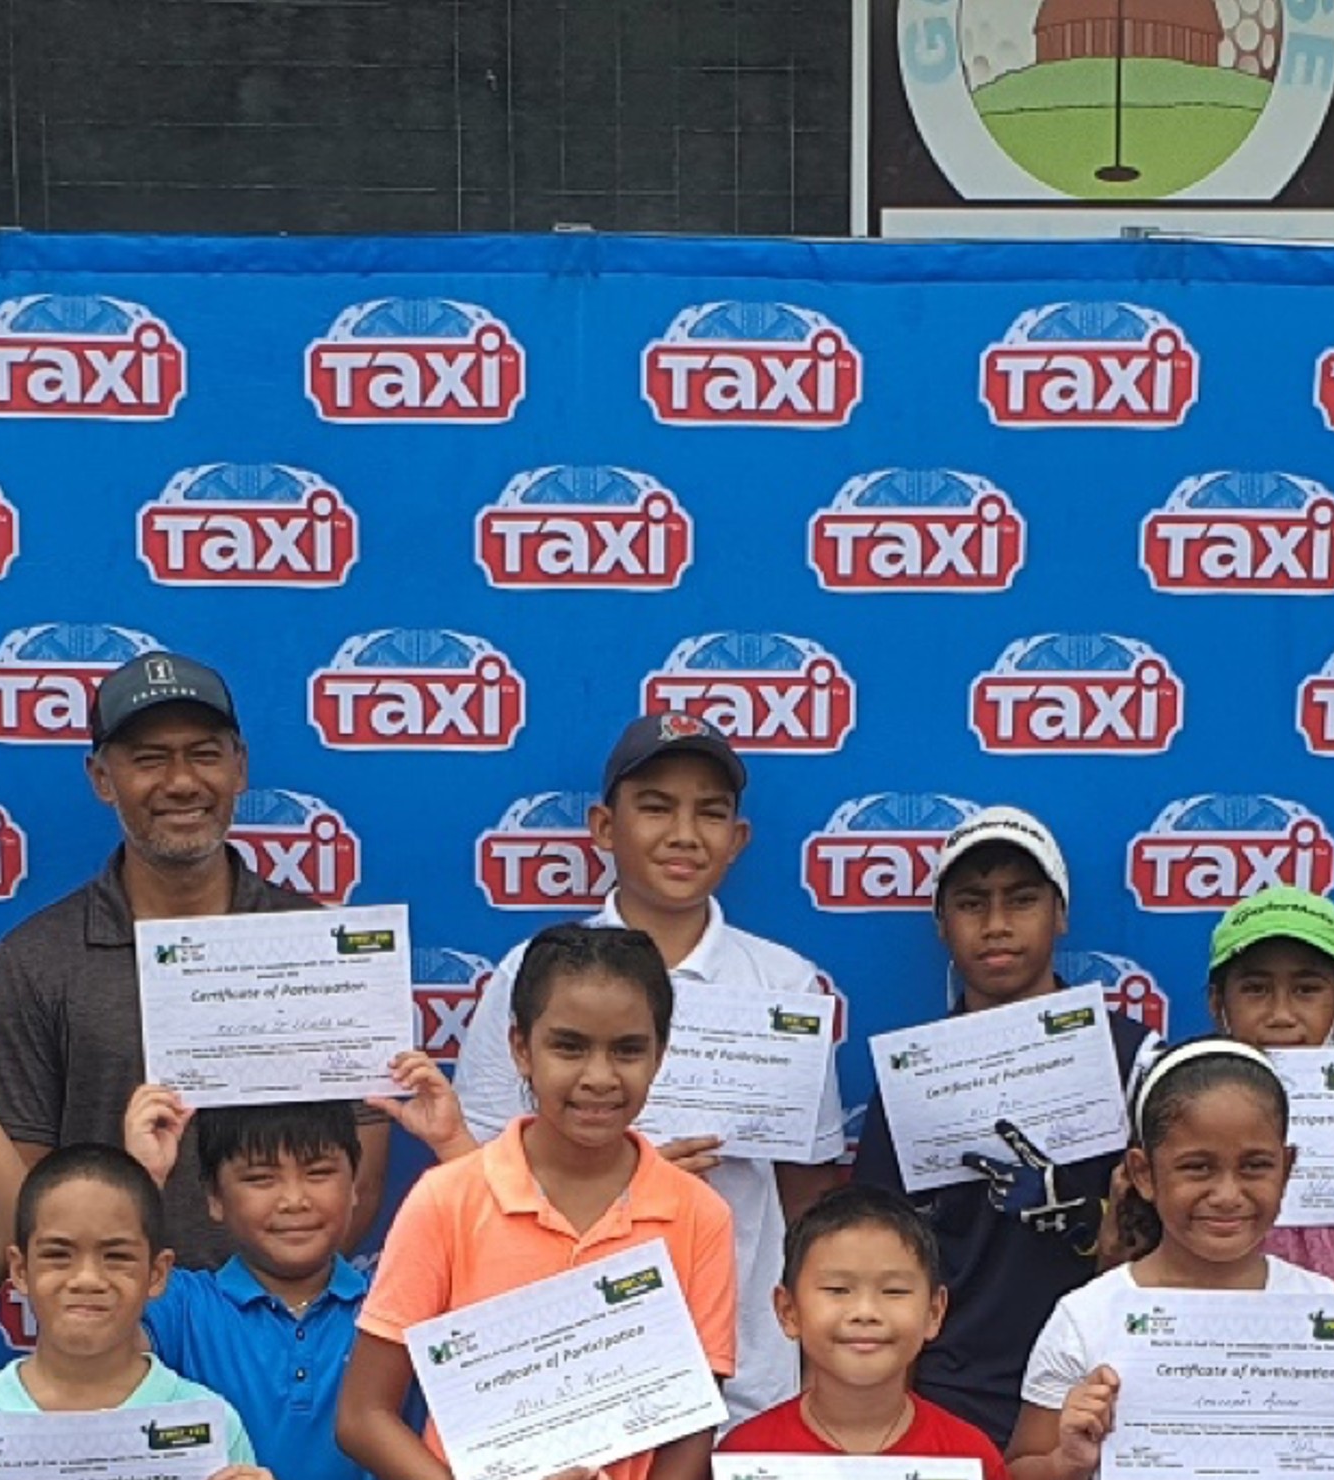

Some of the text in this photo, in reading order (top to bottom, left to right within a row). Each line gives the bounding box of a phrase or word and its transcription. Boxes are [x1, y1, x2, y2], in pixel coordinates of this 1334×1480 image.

[321, 331, 502, 409] Taxi
[658, 337, 837, 413] Taxi
[996, 336, 1175, 414] Taxi
[154, 497, 334, 573] Taxi
[491, 500, 669, 575] Taxi
[824, 502, 1001, 578] Taxi
[1157, 506, 1334, 581] Taxi
[324, 659, 502, 737] Taxi
[986, 667, 1160, 741] Taxi
